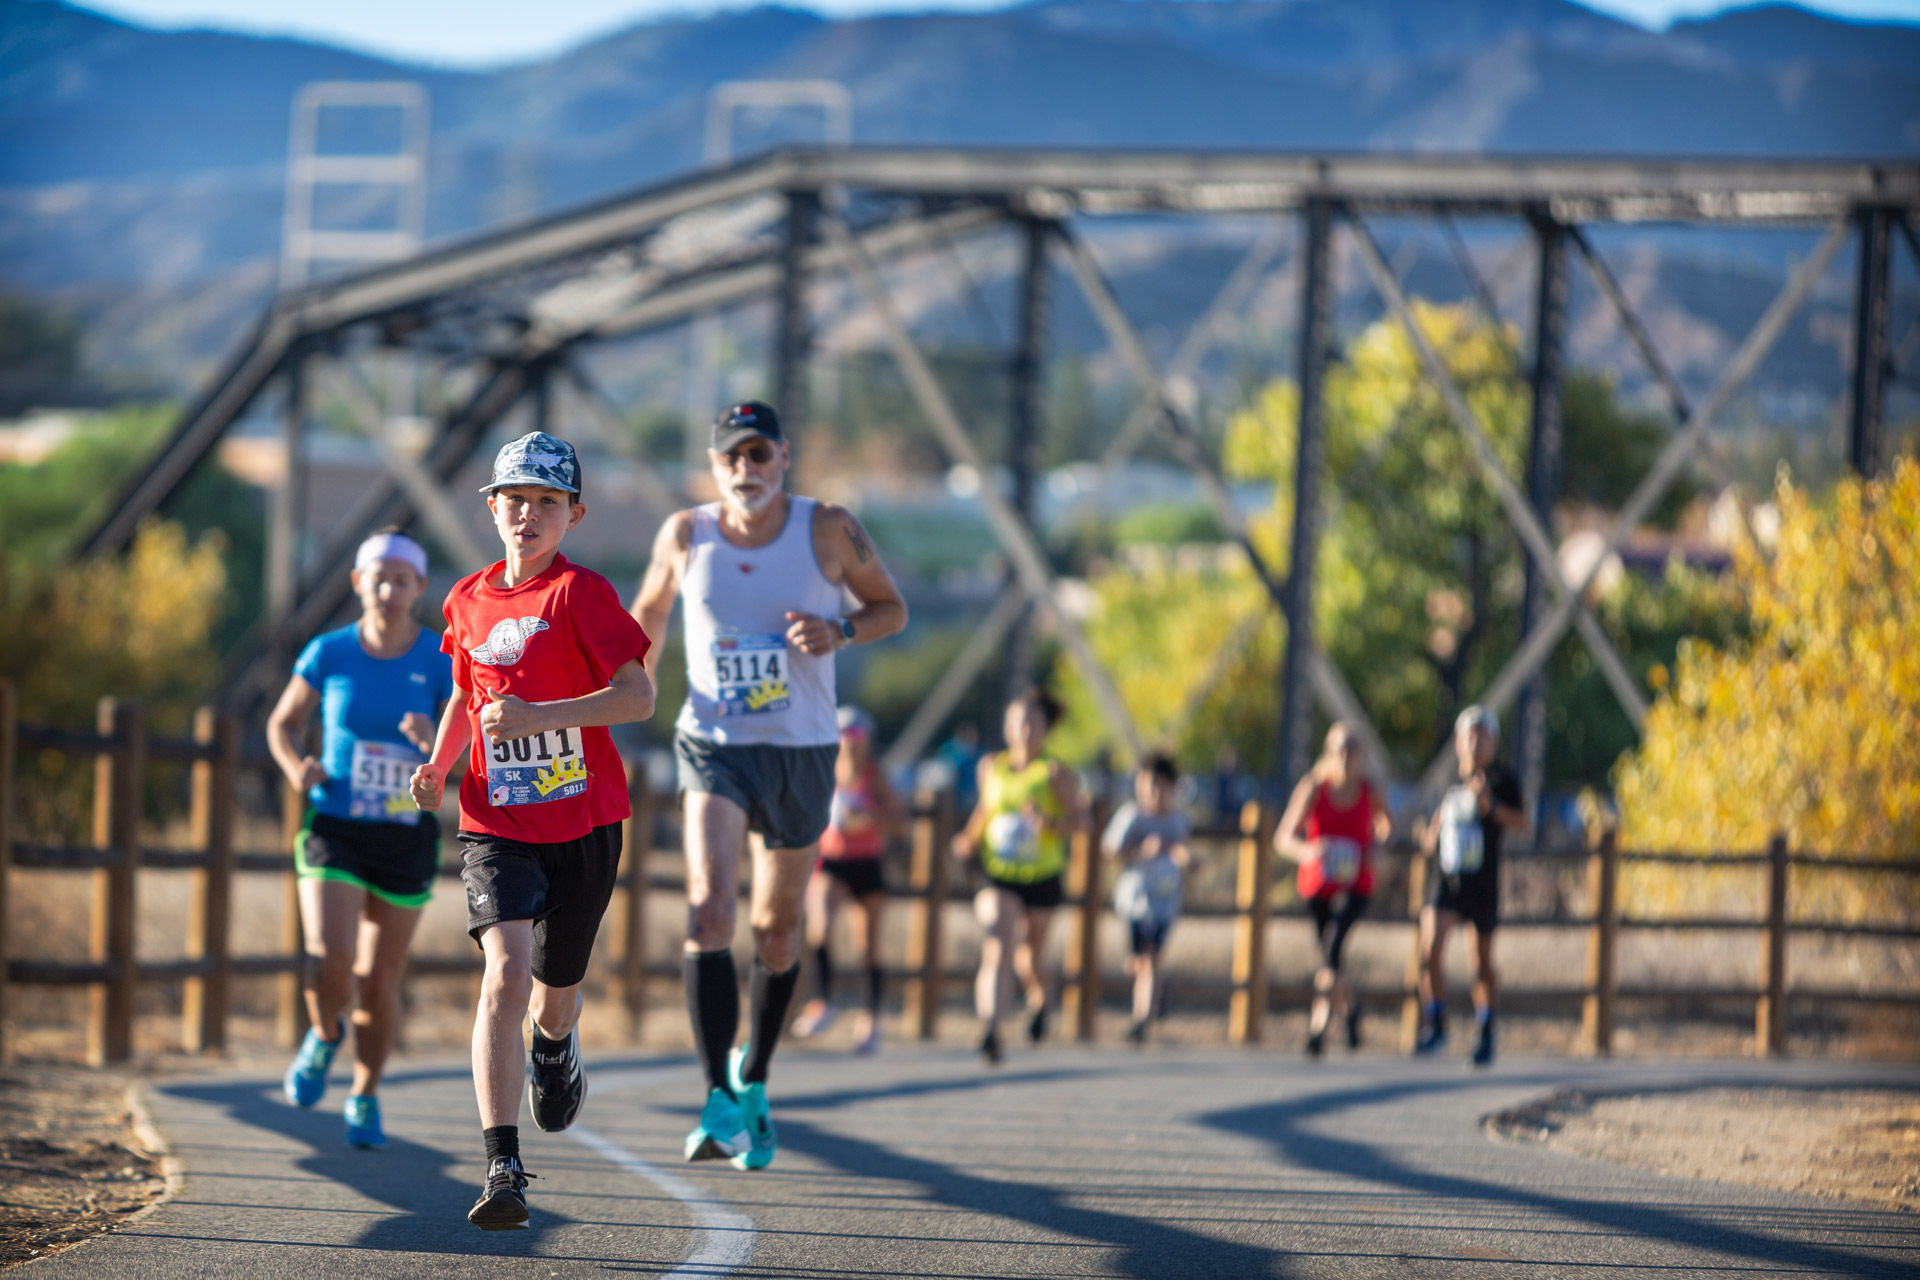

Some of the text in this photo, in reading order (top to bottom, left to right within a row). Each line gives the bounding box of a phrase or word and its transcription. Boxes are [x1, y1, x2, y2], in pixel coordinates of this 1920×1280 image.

[717, 654, 781, 681] 5114
[358, 761, 416, 788] 511
[505, 771, 521, 781] 5K
[564, 783, 584, 796] 5011
